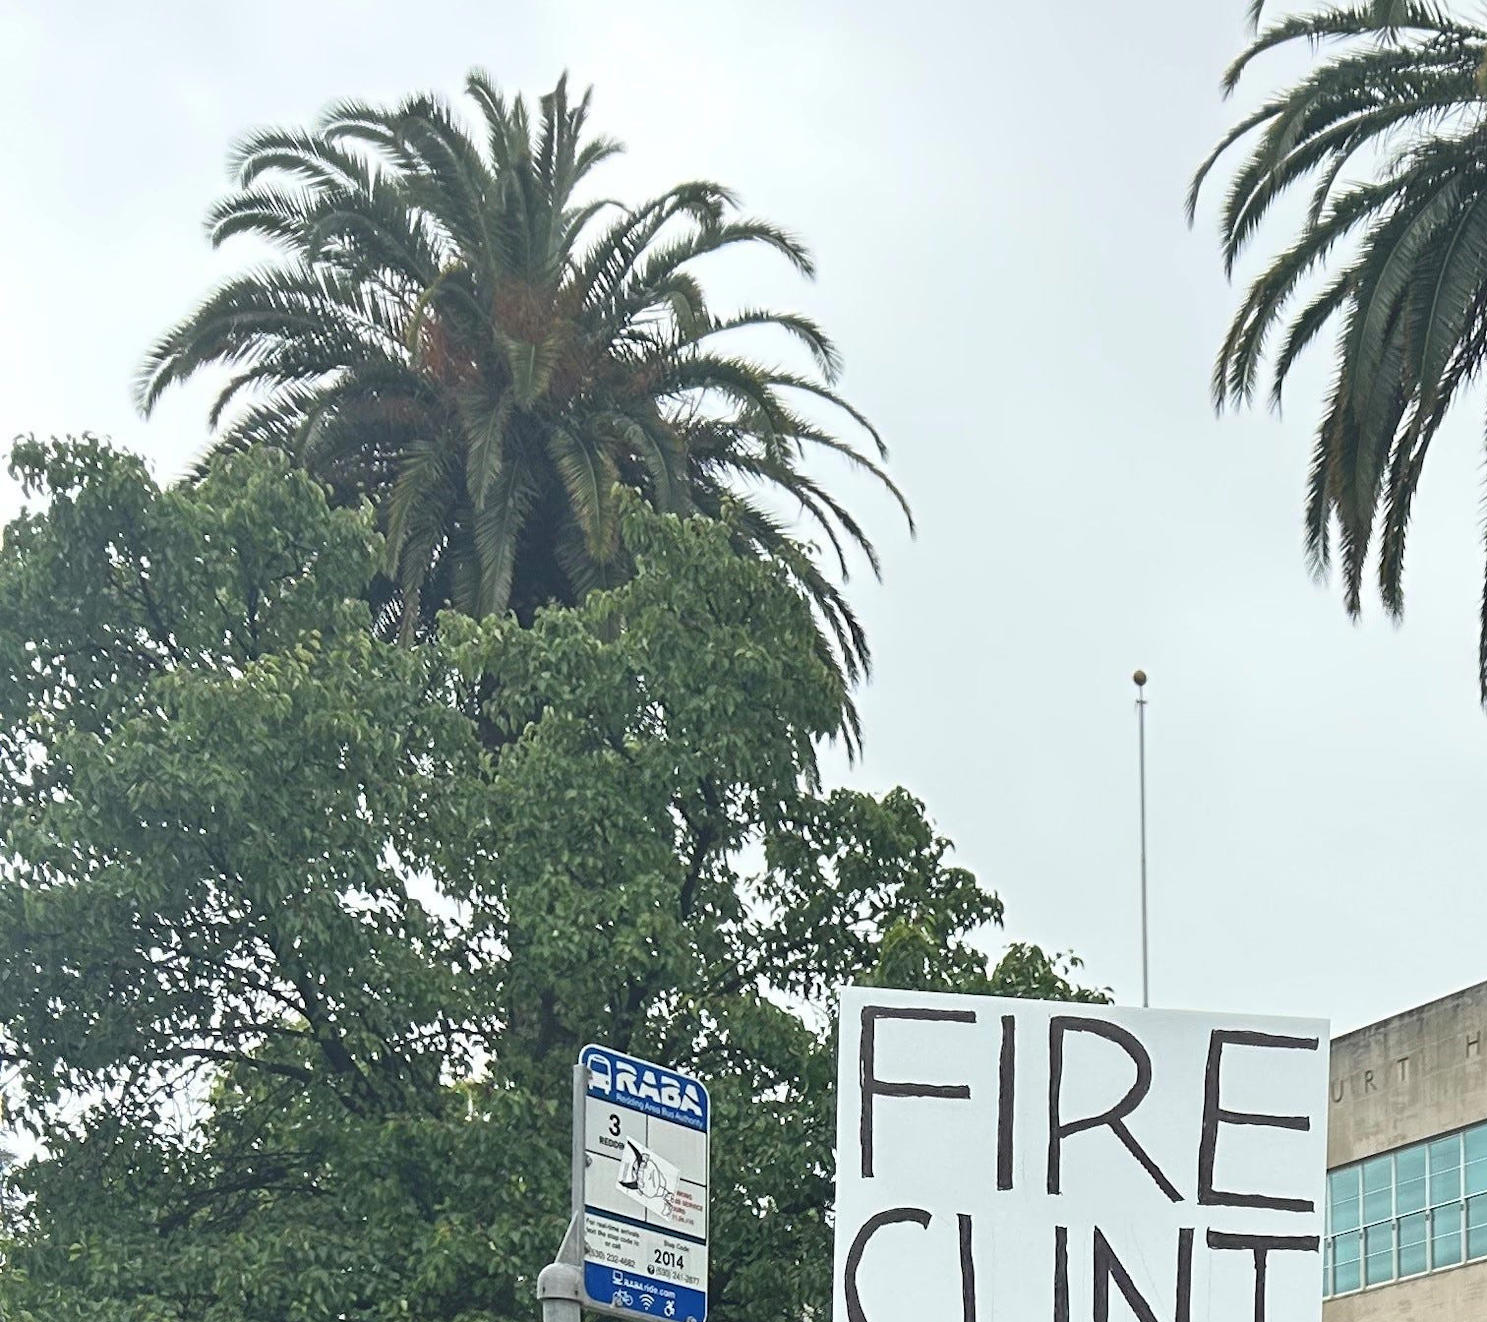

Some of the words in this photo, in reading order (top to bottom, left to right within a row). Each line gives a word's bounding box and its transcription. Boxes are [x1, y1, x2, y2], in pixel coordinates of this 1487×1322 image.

[616, 1061, 703, 1117] RABA
[609, 1114, 621, 1136] 3
[860, 1005, 1319, 1213] FIRE
[654, 1249, 684, 1269] 2014
